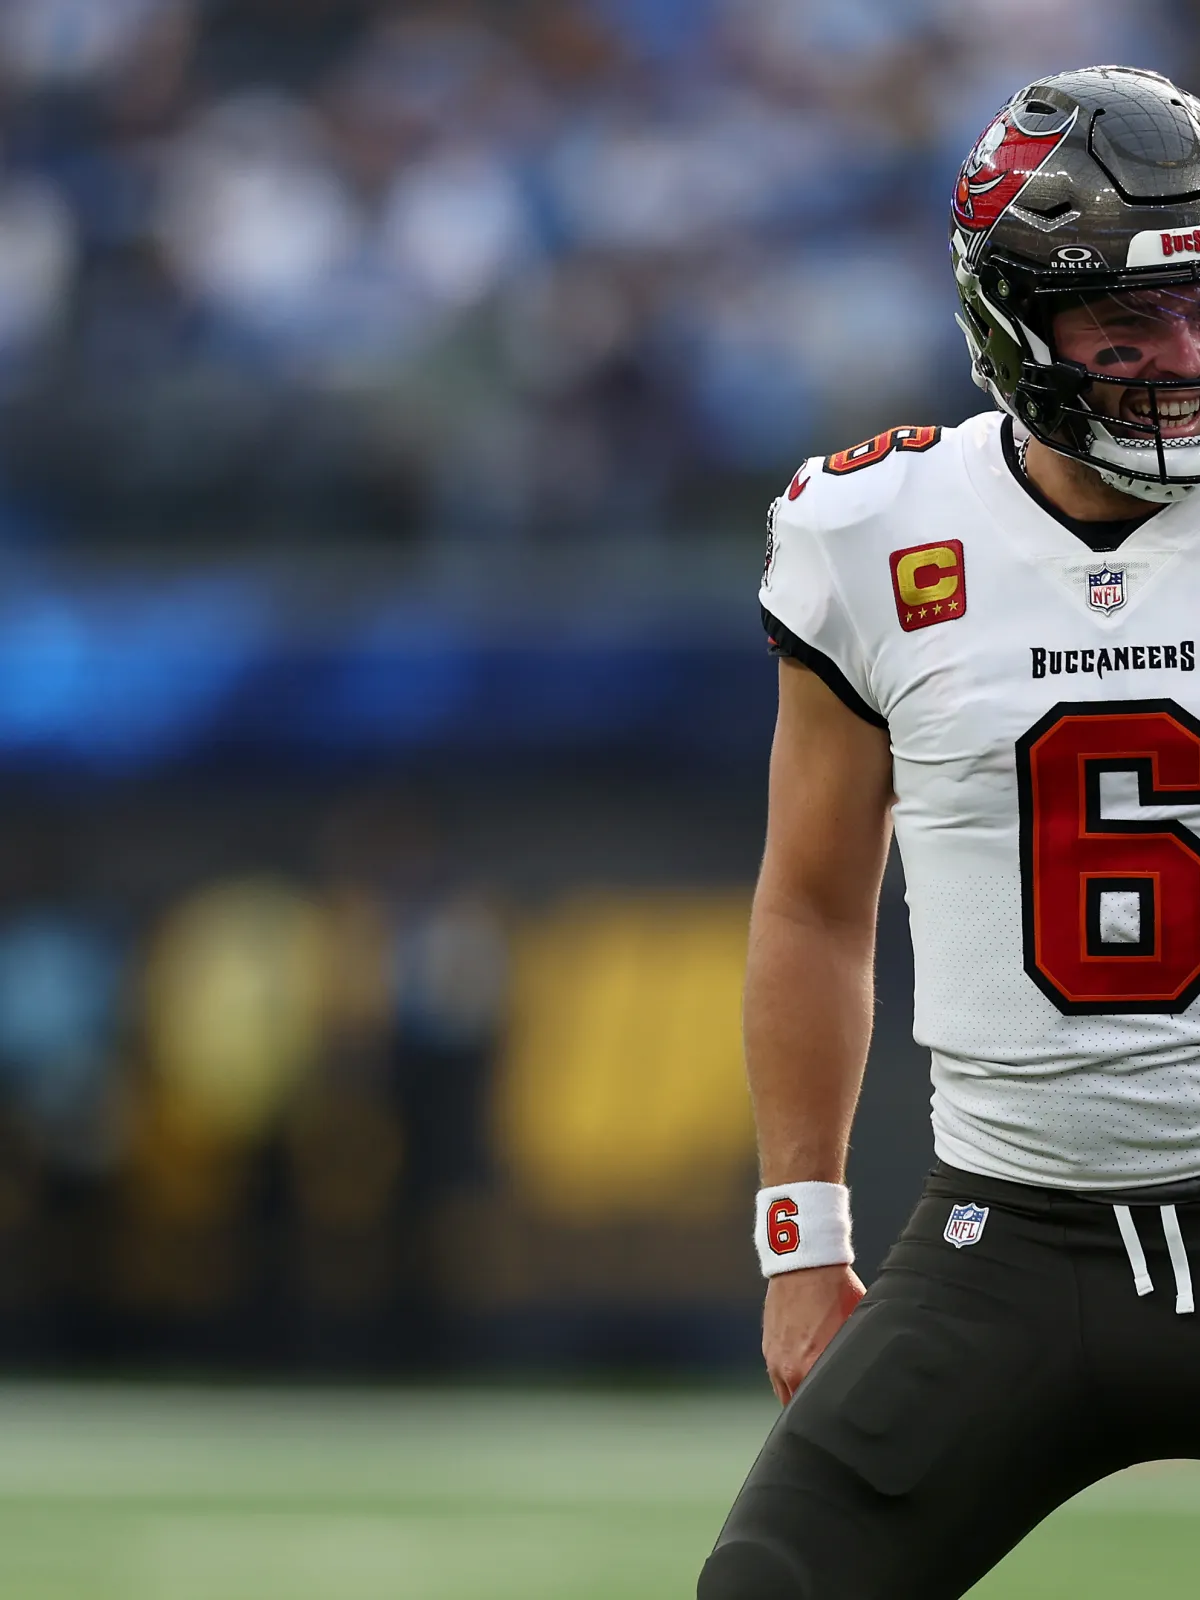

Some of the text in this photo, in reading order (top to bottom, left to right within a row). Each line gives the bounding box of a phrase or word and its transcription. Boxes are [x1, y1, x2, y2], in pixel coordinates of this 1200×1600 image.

[1051, 261, 1101, 269] OAKLEY
[897, 546, 959, 607] C
[1092, 586, 1120, 606] NFL
[1029, 640, 1195, 679] BUCCANEERS
[767, 1197, 800, 1255] 6
[950, 1220, 976, 1239] NFL
